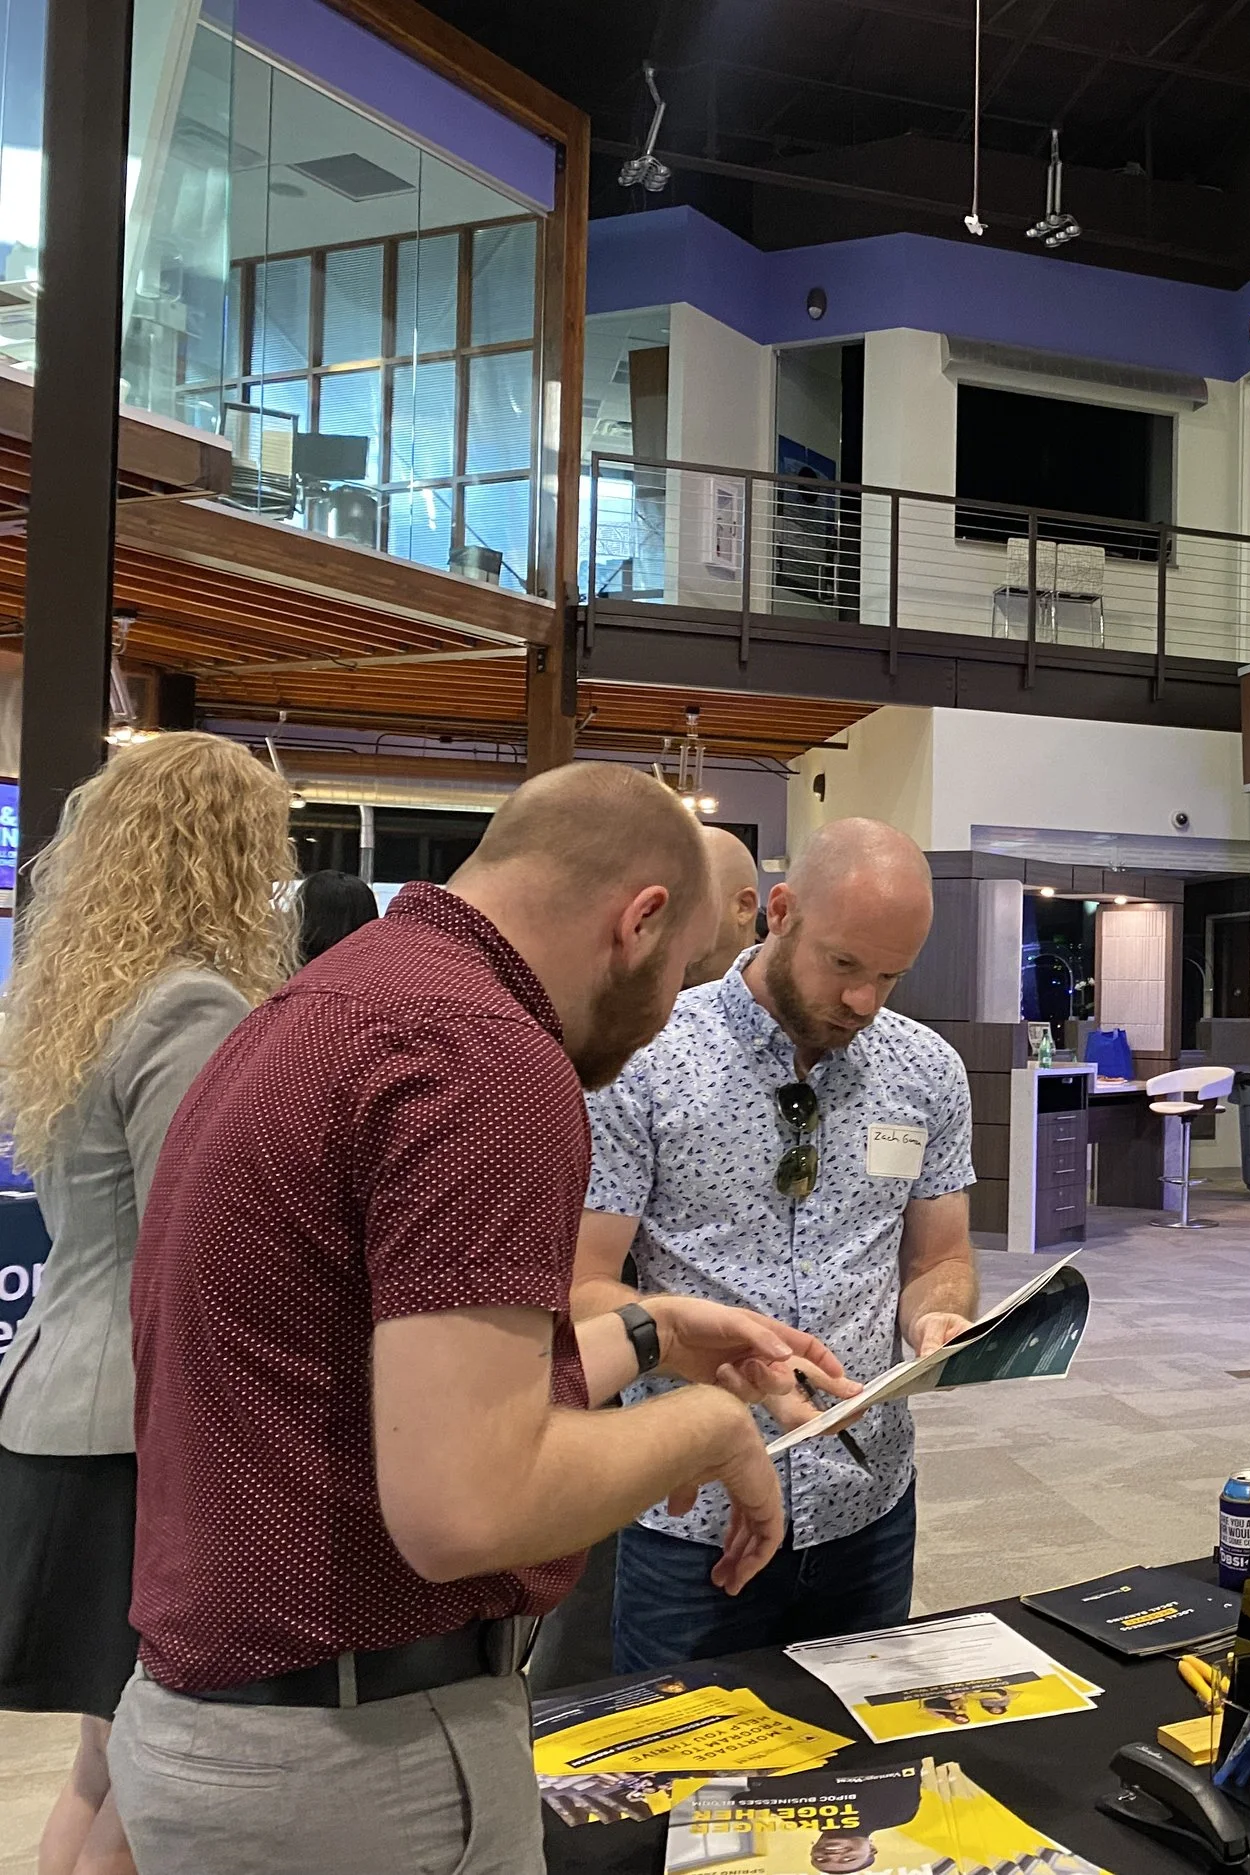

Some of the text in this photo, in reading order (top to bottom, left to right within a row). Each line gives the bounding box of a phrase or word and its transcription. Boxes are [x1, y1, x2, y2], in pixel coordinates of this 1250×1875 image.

[1228, 1526, 1250, 1539] WOUL
[1230, 1518, 1245, 1528] YOU
[630, 1715, 770, 1763] HELP YOU THRIVE
[680, 1720, 783, 1756] PROGRAM TO
[693, 1730, 781, 1763] MORTGAGE
[739, 1795, 818, 1807] BUSINESSES
[819, 1794, 857, 1803] BIPOC
[693, 1803, 860, 1822] TOGETHER
[690, 1816, 861, 1835] STRONGER
